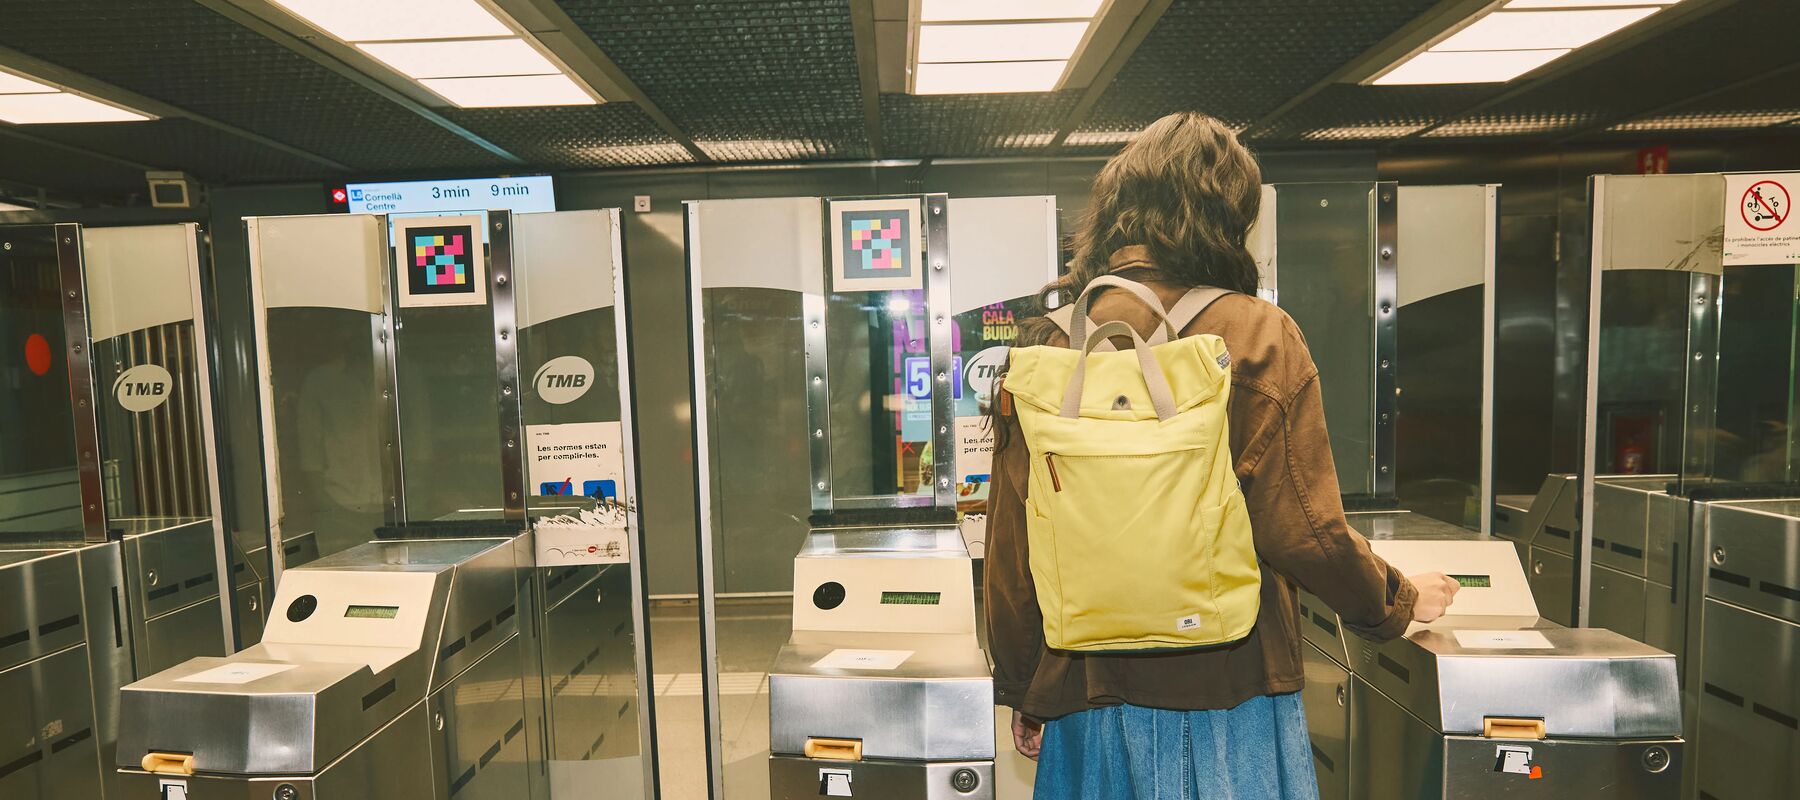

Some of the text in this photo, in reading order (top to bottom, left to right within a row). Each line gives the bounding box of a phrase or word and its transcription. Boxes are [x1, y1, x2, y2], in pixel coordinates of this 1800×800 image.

[431, 185, 470, 199] 3 min
[490, 183, 529, 196] 9 min
[365, 192, 402, 202] Cornellà
[366, 203, 396, 211] Centre
[982, 310, 1014, 325] CALA
[983, 325, 1019, 341] BUIDA
[546, 374, 587, 388] TMB
[125, 382, 165, 396] TMB
[553, 452, 600, 461] complir-les.
